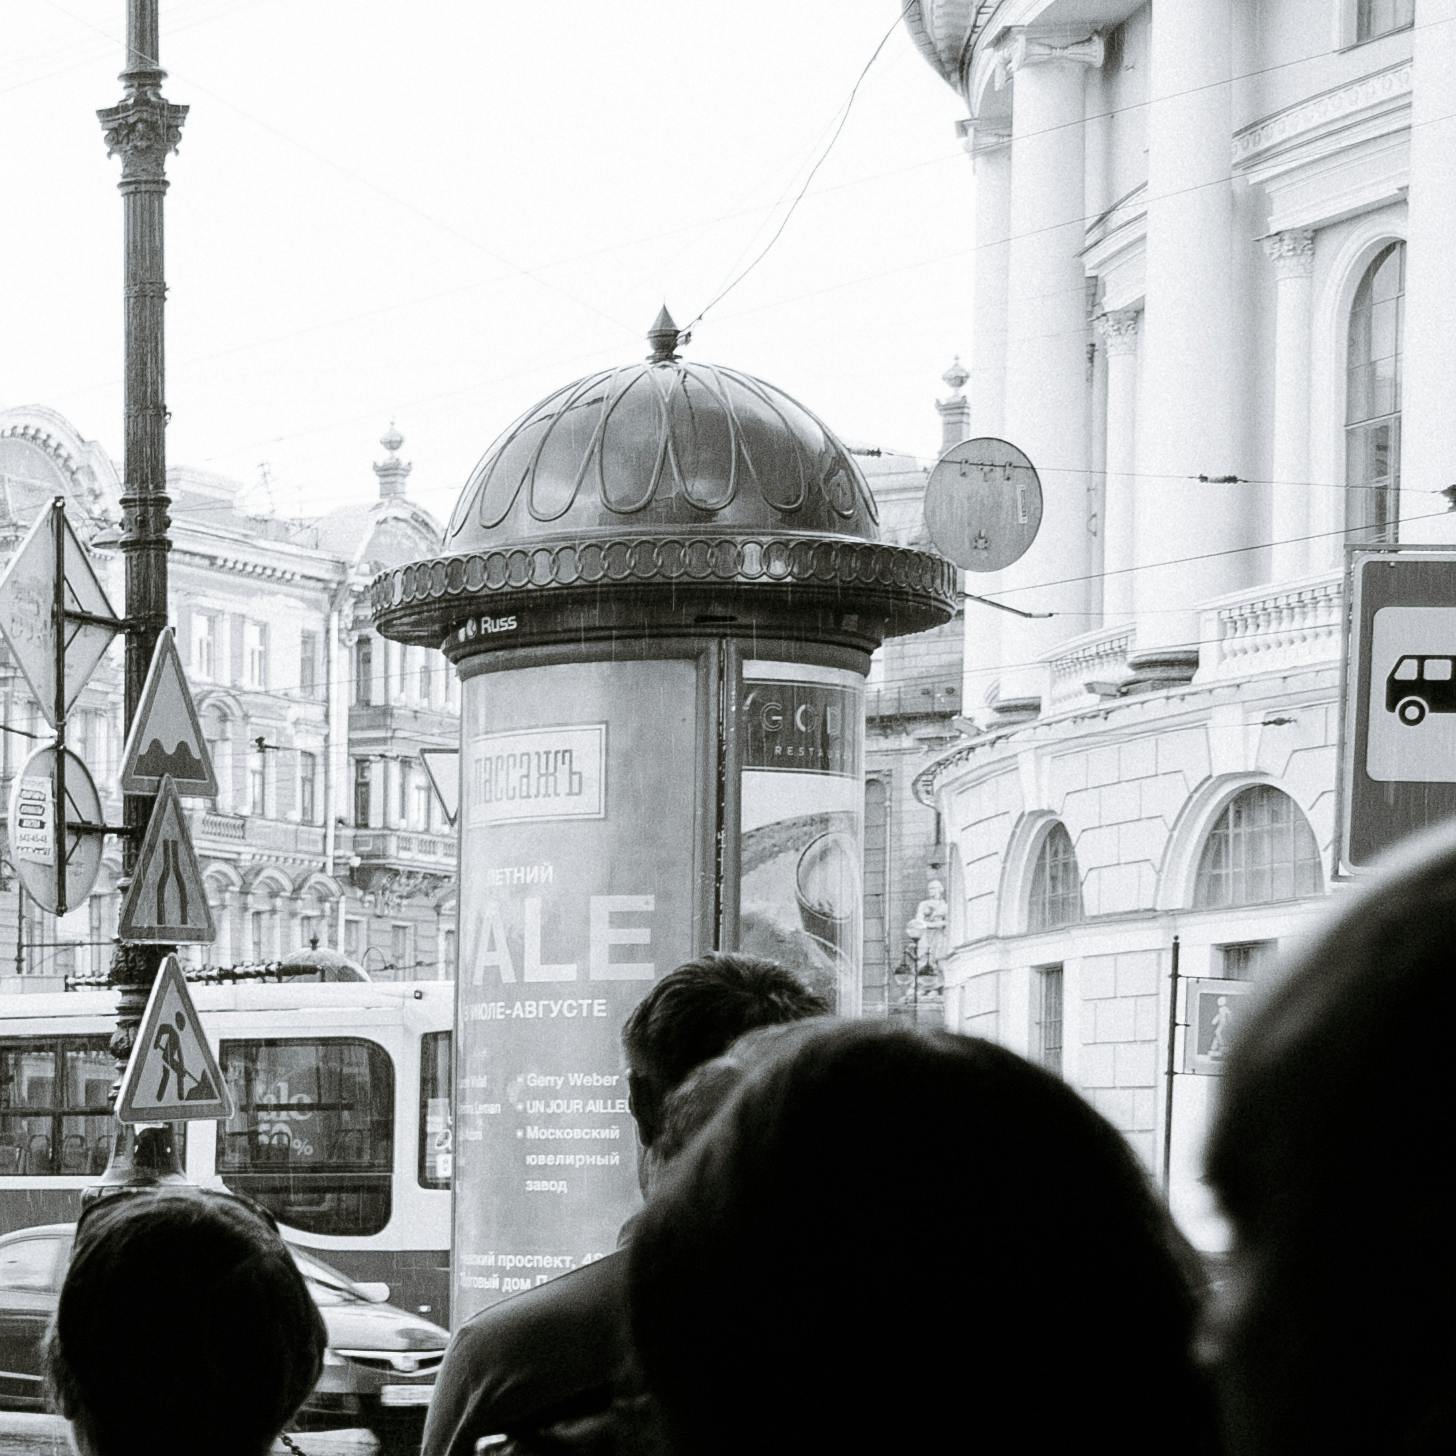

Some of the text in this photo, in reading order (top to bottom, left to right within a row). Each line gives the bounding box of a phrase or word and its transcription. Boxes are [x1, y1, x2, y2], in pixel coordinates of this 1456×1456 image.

[481, 616, 518, 635] Russ
[466, 895, 655, 985] ALE
[527, 1073, 620, 1089] Gerry Weber
[526, 1100, 545, 1113] UN
[546, 1100, 583, 1113] JOUR
[526, 1126, 620, 1139] Московский
[526, 1152, 620, 1167] ювелирный
[525, 1180, 568, 1194] завод
[498, 1254, 576, 1270] проспект,
[502, 1277, 531, 1292] дом
